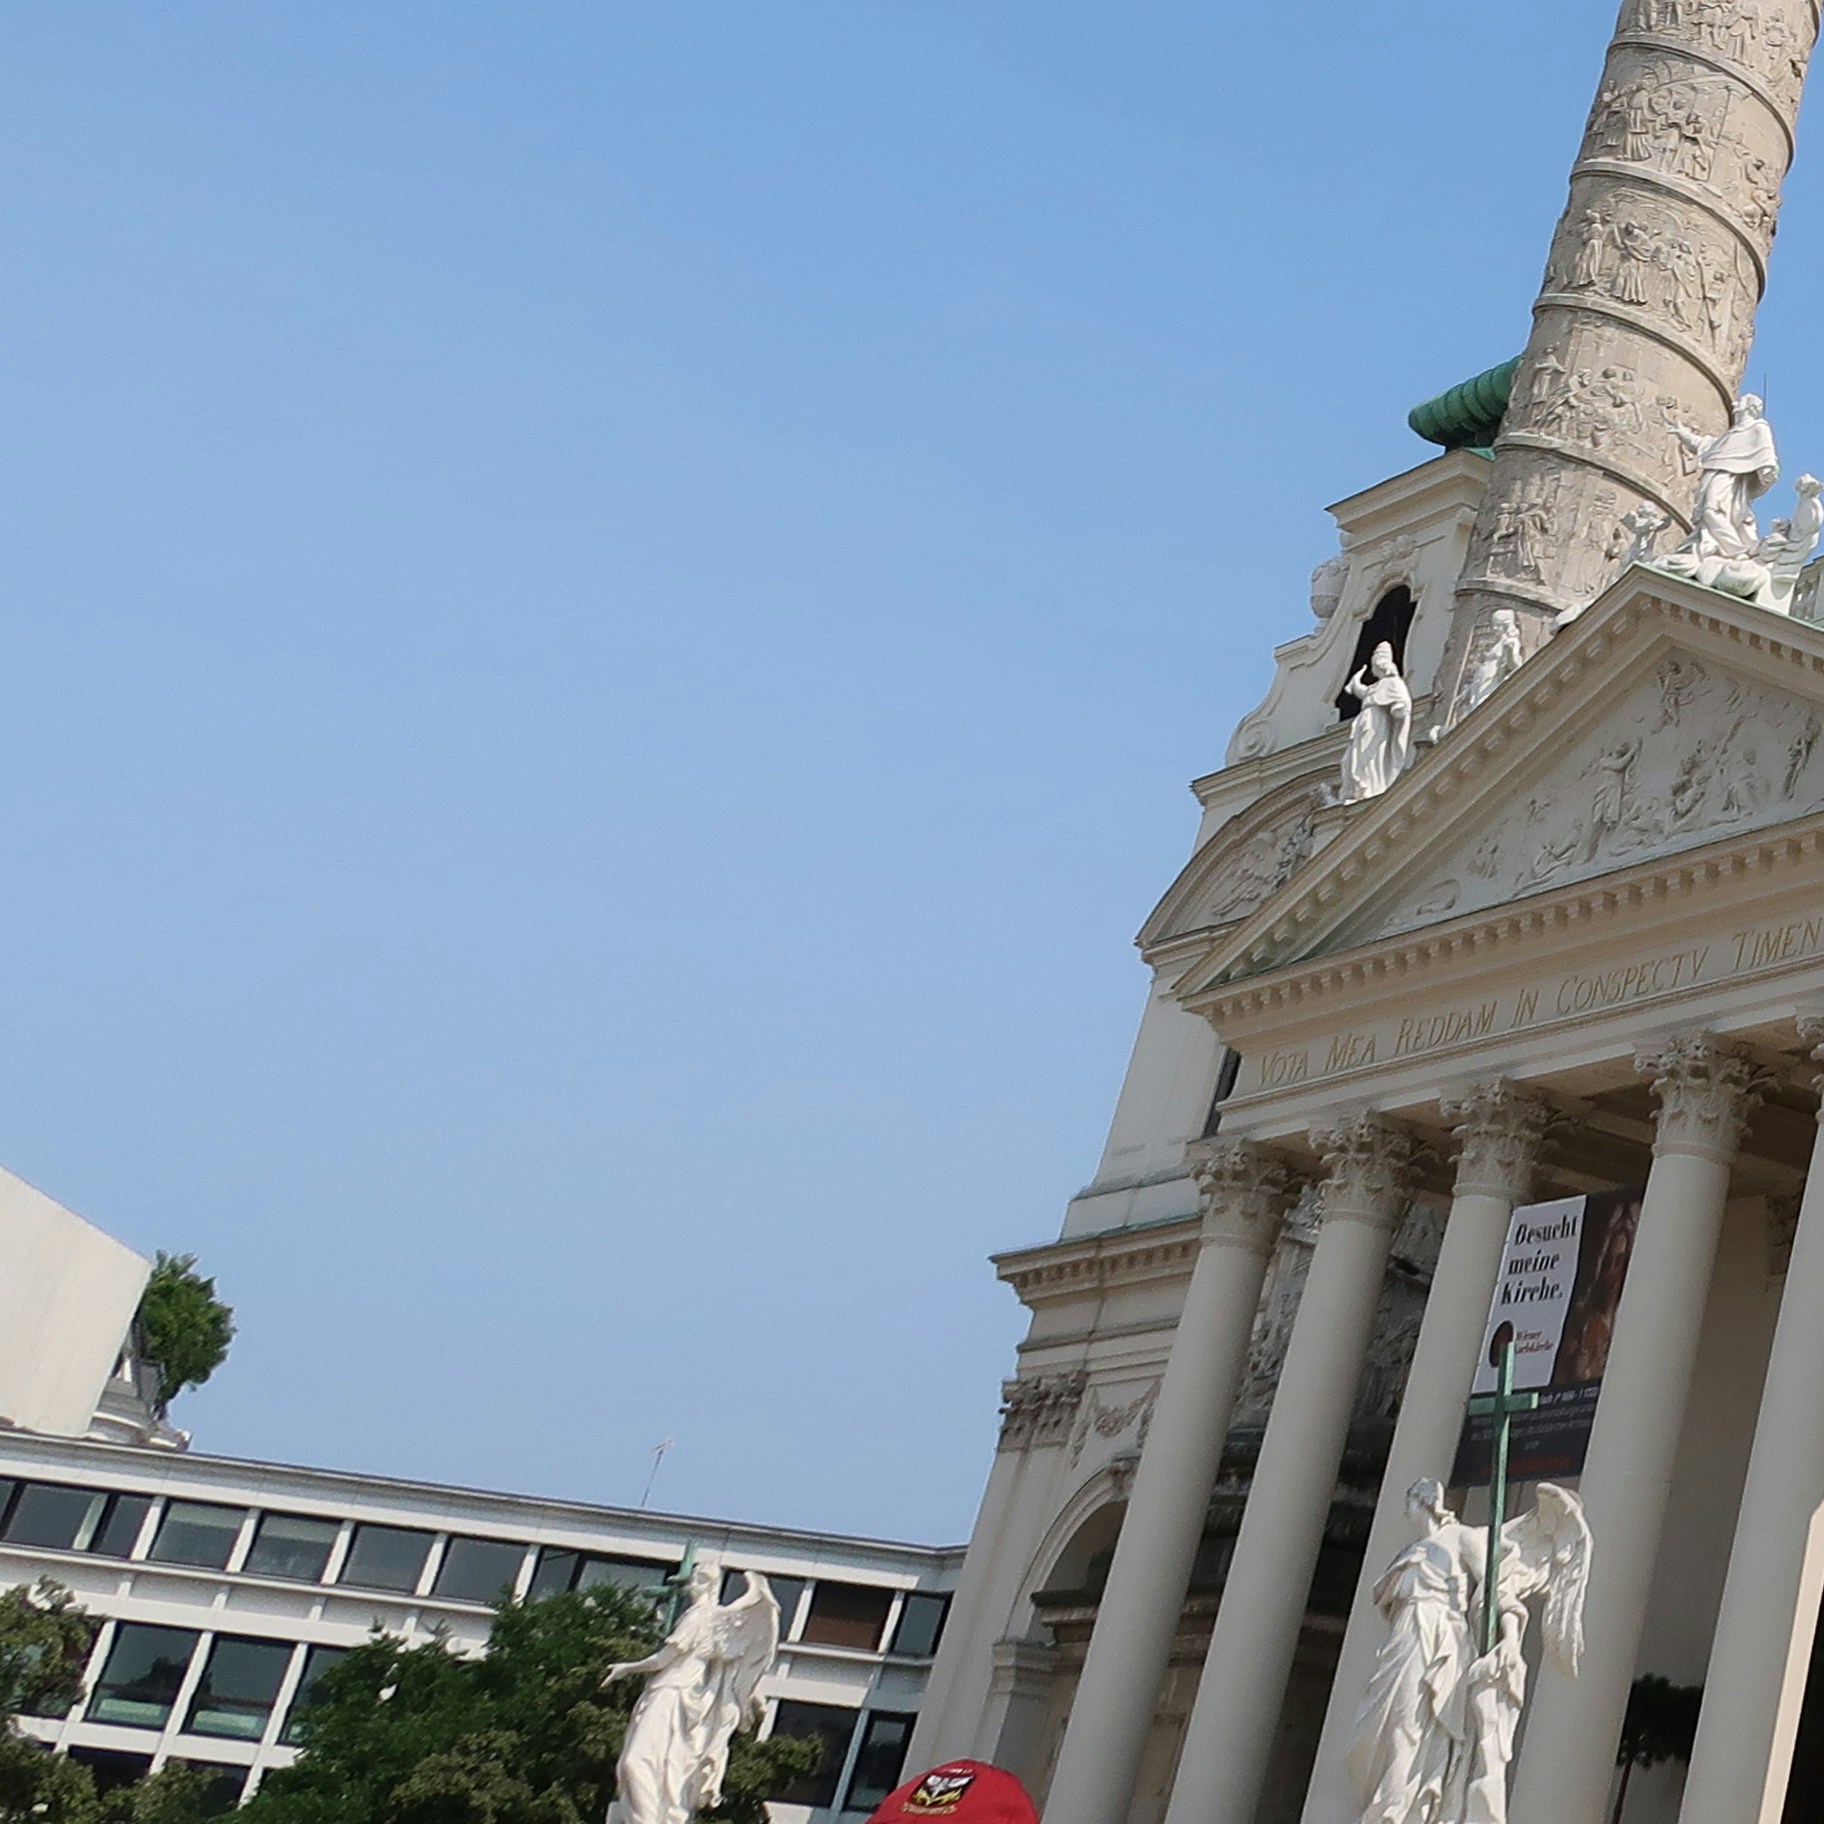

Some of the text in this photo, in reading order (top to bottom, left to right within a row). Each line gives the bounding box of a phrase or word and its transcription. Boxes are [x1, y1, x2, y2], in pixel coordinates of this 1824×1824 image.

[1260, 1050, 1308, 1085] VOTA
[1325, 1033, 1377, 1072] MEA
[1395, 1000, 1498, 1054] REDDAM
[1511, 987, 1540, 1027] IN
[1557, 947, 1709, 1014] CONSPECTV
[1508, 1249, 1560, 1275] meine
[1501, 1276, 1563, 1305] Kirche.
